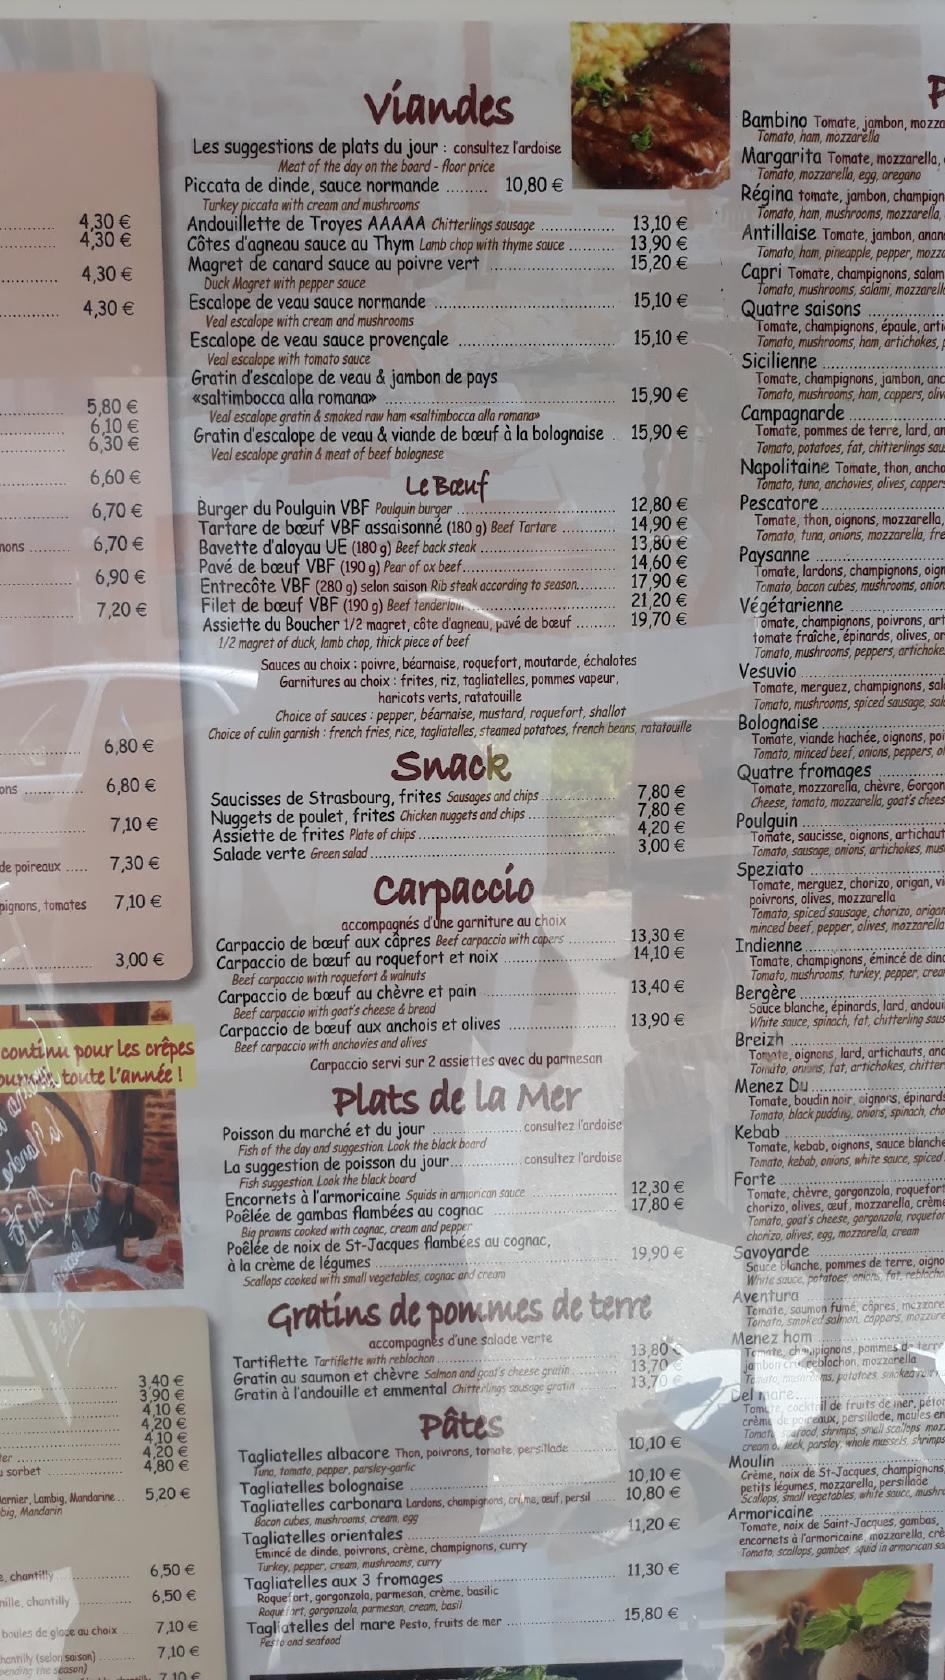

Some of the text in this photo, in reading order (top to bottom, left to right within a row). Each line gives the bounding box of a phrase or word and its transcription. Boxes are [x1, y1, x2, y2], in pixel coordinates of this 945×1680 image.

[363, 79, 514, 127] Viandes
[742, 110, 808, 128] Bambino
[758, 128, 880, 144] Tomato, ham, mozzarella
[741, 148, 940, 169] Margarita Tomate, mozzarella,
[758, 167, 921, 184] Tomato, mozzarella, egg, oregano
[185, 176, 564, 196] Piccata de dinde, sauce normande 10,80 €
[203, 197, 419, 214] Turkey piccata with cream and mushrooms
[79, 213, 131, 232] 4,30 €
[187, 214, 688, 236] Andouillette de Troyes AAAAA Chitterlings sausage 13,10 €
[83, 300, 135, 319] 4,30 €
[742, 299, 861, 320] Quatre saisons
[191, 330, 688, 352] Escalope de veau sauce provençale 15,10 €
[742, 351, 818, 369] Sicilienne
[741, 403, 845, 425] Campagnarde
[90, 469, 141, 487] 6,60 €
[406, 470, 490, 503] Le Bœuf
[198, 497, 688, 520] Burger du Poulguin VBF Poulguin burger 12,80 €
[740, 494, 818, 511] Pescatore
[97, 602, 147, 620] 7,20 €
[740, 595, 844, 617] Végétarienne
[739, 663, 796, 678] Vesuvio
[104, 738, 154, 756] 6,80 €
[390, 744, 512, 782] Snack
[737, 762, 871, 783] Quatre fromages
[211, 802, 685, 828] Nuggets de poulet, frites Chicken nuggets and chips 7,80 €
[213, 839, 685, 861] Salade verte Green salad 3,00 €
[15, 856, 160, 876] poireaux 7,30 €
[373, 863, 534, 919] Carpaccio
[750, 890, 895, 909] poivrons, olives, mozzarella
[43, 899, 87, 911] tomates
[735, 937, 802, 953] Indienne
[218, 980, 685, 1007] Carpaccio de bœuf au chèvre et pain 13,40 €
[1, 1035, 195, 1065] continu pour les crêpes
[235, 1036, 427, 1055] Beef carpaccio with anchovies and olives
[61, 1071, 105, 1085] toute
[109, 1062, 173, 1084] l'année
[332, 1078, 582, 1117] Plats de la Mer
[734, 1124, 780, 1140] Kebab
[240, 1177, 259, 1188] Fish
[317, 1174, 340, 1187] Look
[343, 1172, 358, 1185] the
[361, 1173, 386, 1185] black
[389, 1173, 416, 1184] board
[734, 1171, 776, 1186] Forte
[786, 1227, 814, 1241] olives,
[817, 1231, 835, 1242] egg,
[838, 1225, 888, 1238] mozzarella,
[892, 1228, 919, 1237] cream
[267, 1288, 652, 1338] Gratins de pommes de terre
[139, 1389, 184, 1403] 3,90 €
[419, 1406, 504, 1440] Pâtes
[6, 1466, 41, 1476] sorbet
[728, 1455, 775, 1469] Moulin
[741, 1474, 928, 1495] petits légumes, mozzarella, persillade
[33, 1488, 191, 1506] Lambig, Mandarine 5,20 €
[20, 1507, 62, 1517] Mandarin
[728, 1507, 814, 1520] Armoricaine
[150, 1564, 196, 1579] 6,50 €
[244, 1563, 679, 1595] Tagliatelles aux 3 fromages 11,30 €
